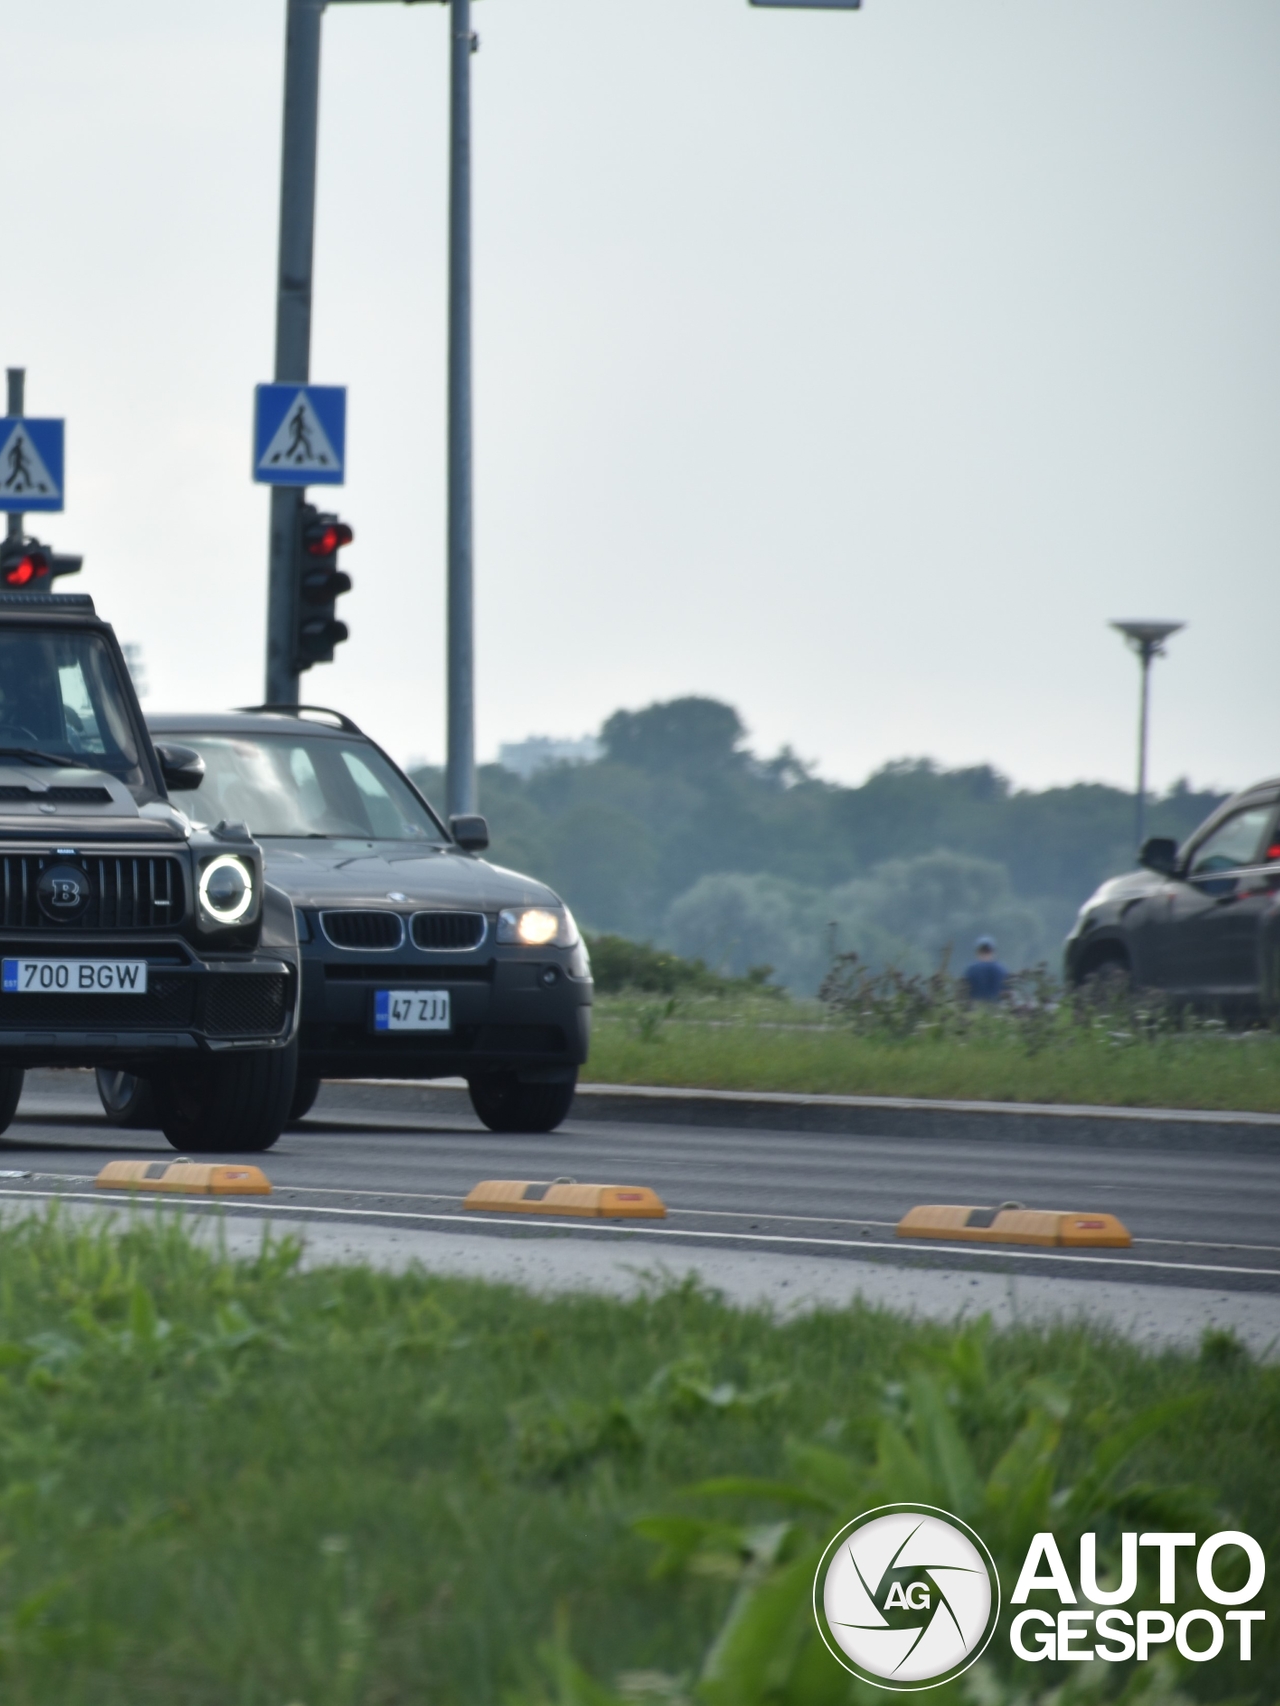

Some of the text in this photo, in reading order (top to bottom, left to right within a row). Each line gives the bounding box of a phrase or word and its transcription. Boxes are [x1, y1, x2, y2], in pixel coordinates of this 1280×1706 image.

[52, 879, 80, 906] B
[24, 964, 139, 989] 700 BGW
[392, 1000, 447, 1021] 47 ZJJ
